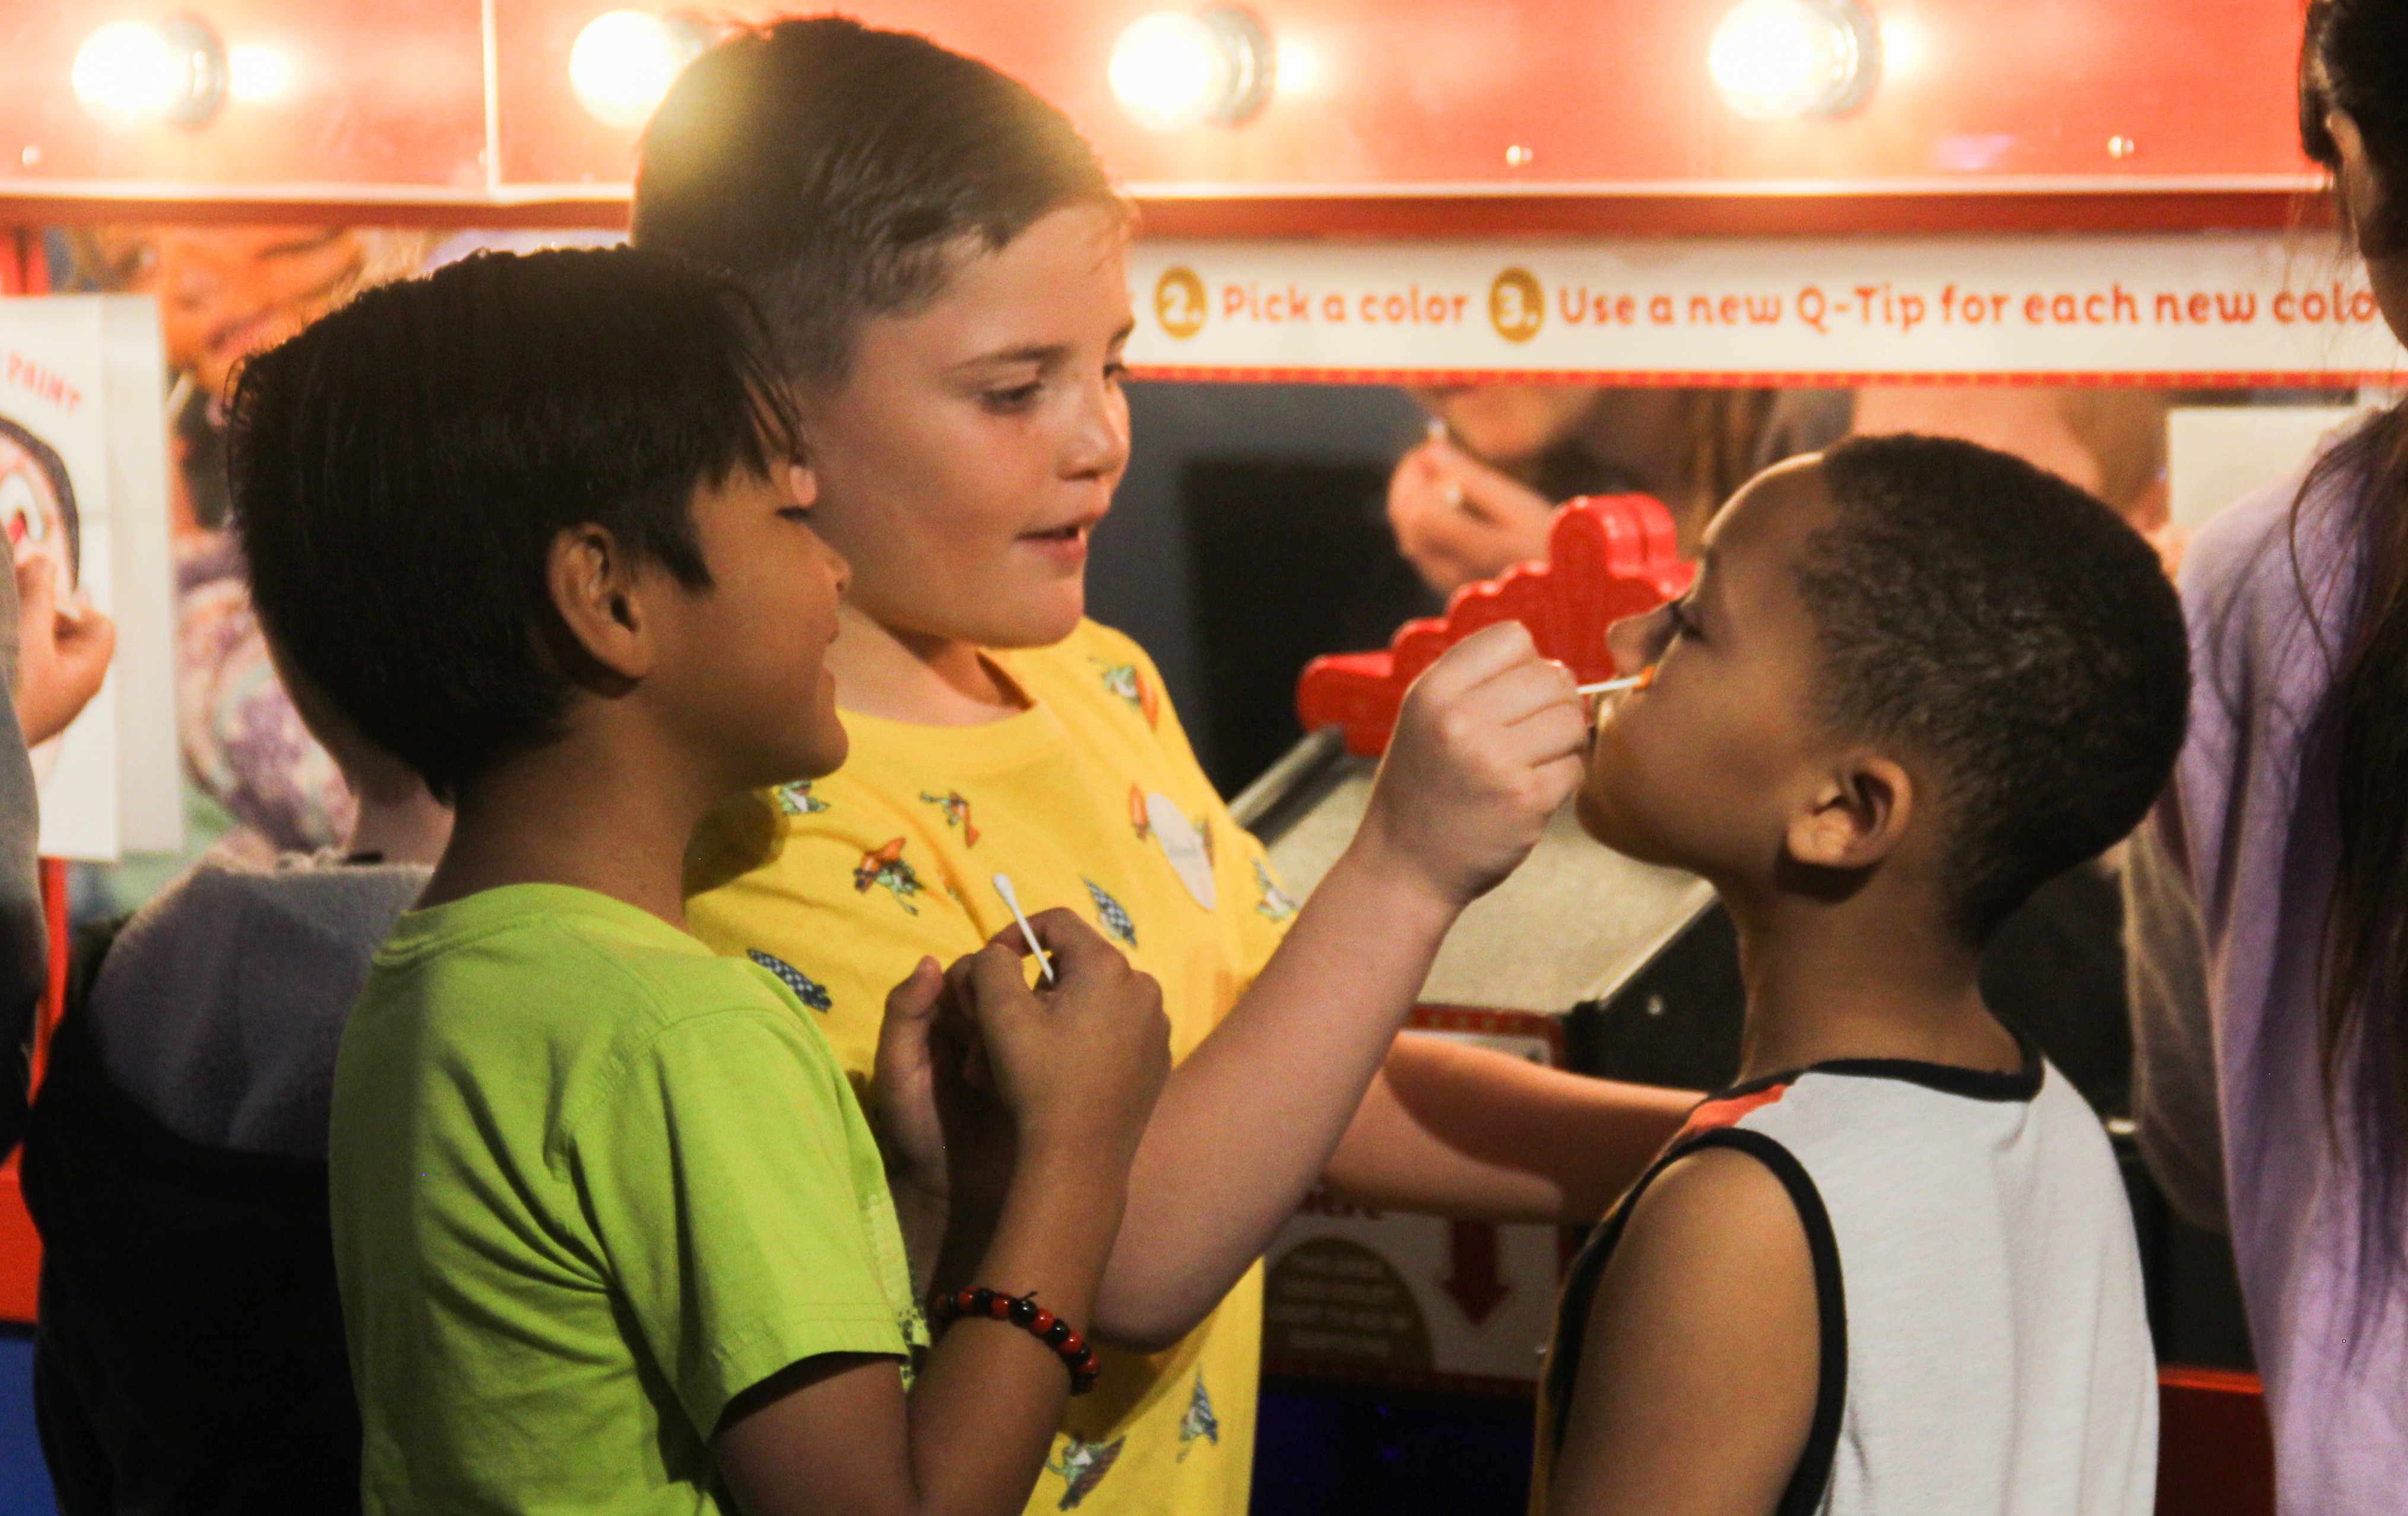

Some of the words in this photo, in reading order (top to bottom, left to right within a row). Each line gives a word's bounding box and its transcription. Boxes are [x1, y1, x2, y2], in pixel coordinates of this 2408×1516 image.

[1163, 284, 1202, 324] 2.
[1223, 284, 1310, 323] Pick
[1322, 293, 1349, 324] a
[1359, 284, 1470, 325] color
[1498, 286, 1539, 328] 3.
[1559, 287, 1637, 327] Use
[1647, 294, 1675, 327] a
[1688, 294, 1783, 326] new
[1795, 284, 1927, 336] Q-Tip
[1939, 283, 2011, 327] for
[2022, 281, 2142, 327] each
[2153, 290, 2258, 326] new
[2271, 281, 2380, 326] colo
